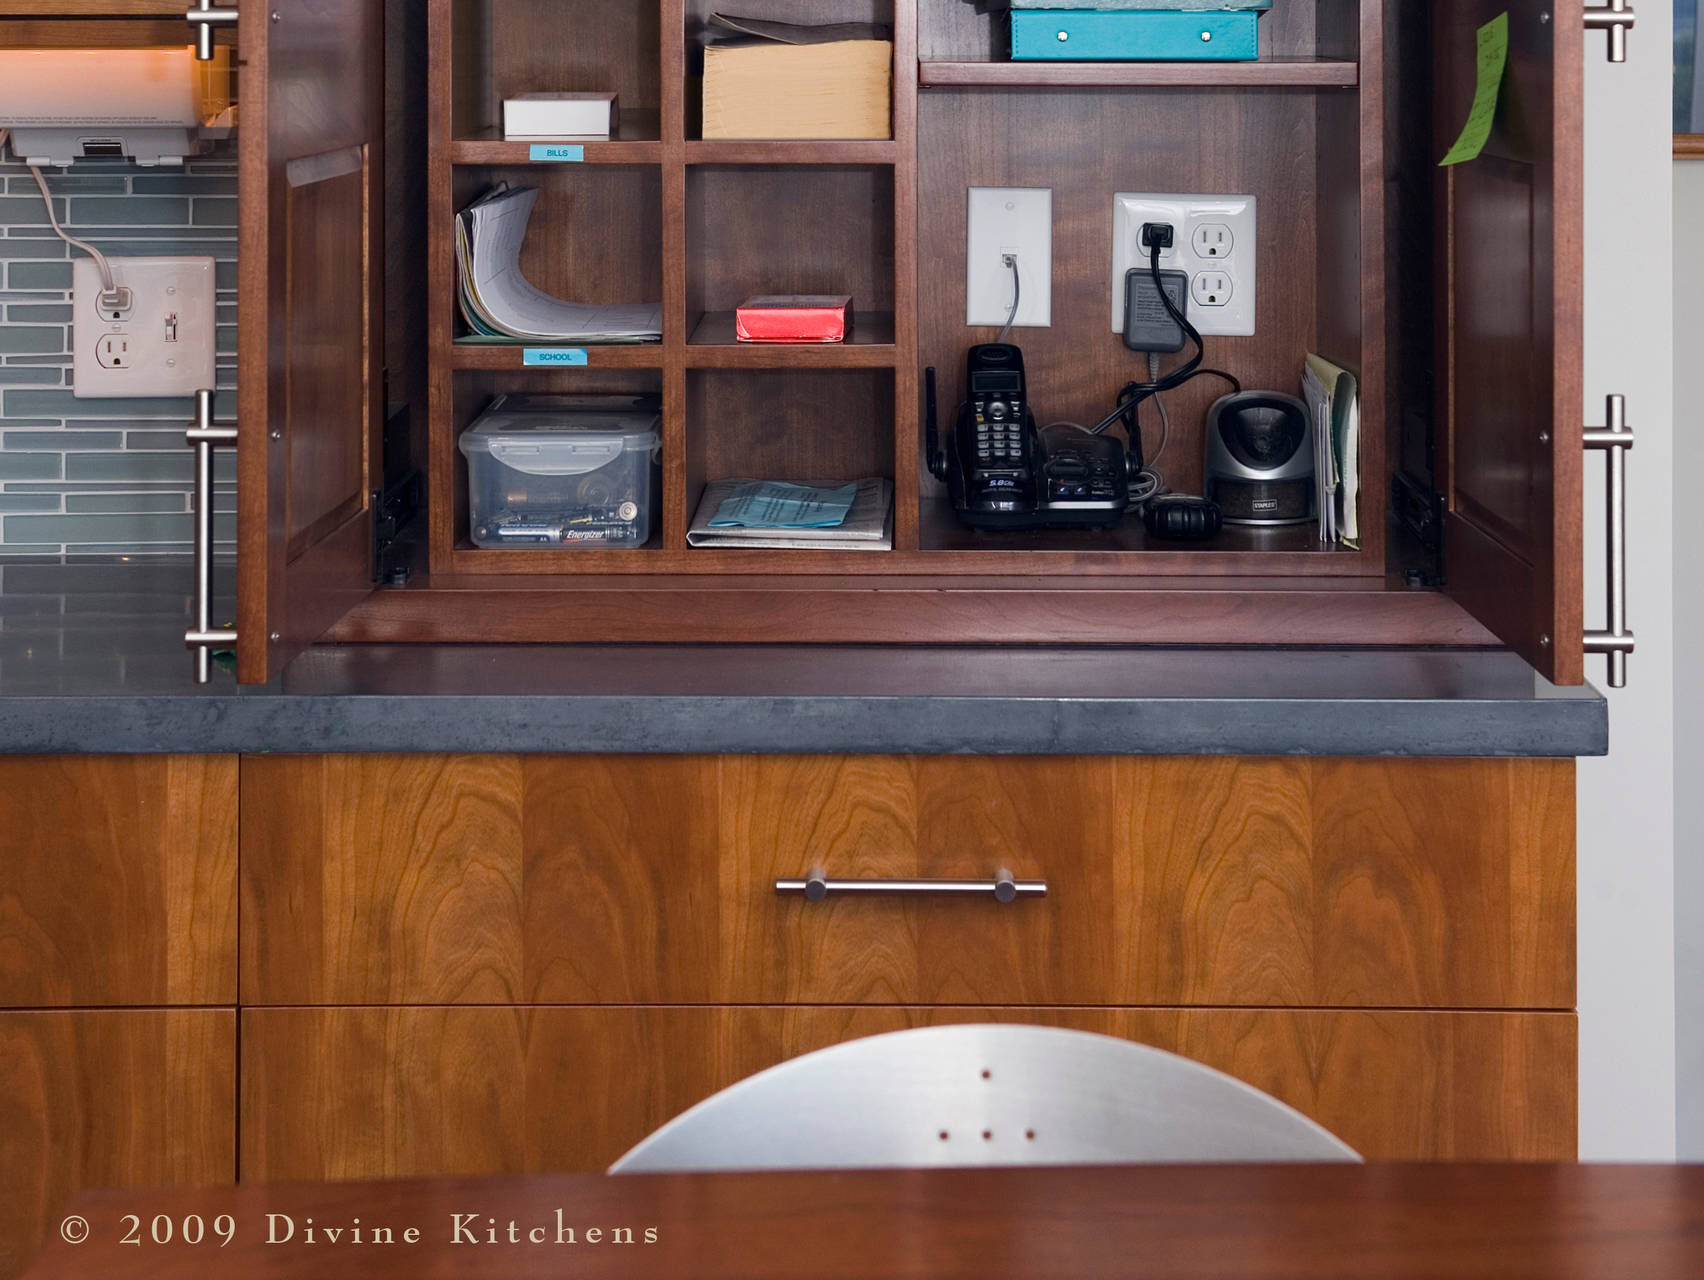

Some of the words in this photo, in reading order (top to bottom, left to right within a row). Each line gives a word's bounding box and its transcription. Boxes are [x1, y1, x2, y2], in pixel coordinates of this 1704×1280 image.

[546, 149, 569, 157] BILLS
[538, 353, 573, 361] SCHOOL
[567, 529, 605, 540] Energizer
